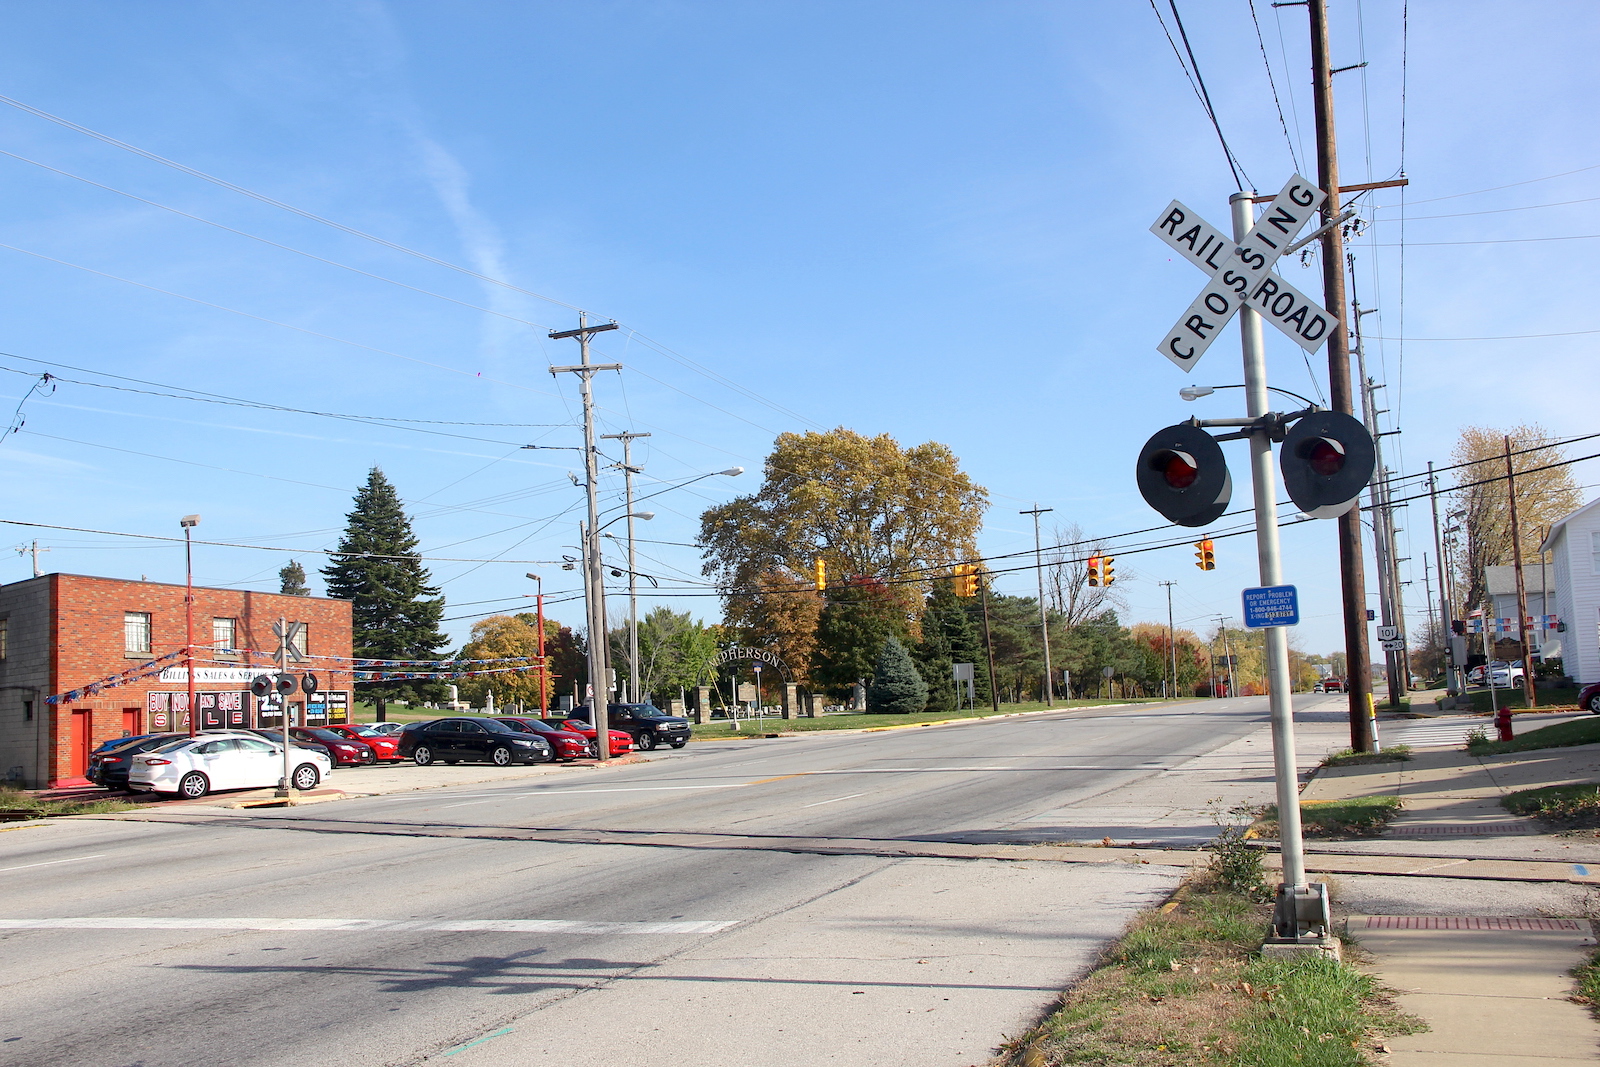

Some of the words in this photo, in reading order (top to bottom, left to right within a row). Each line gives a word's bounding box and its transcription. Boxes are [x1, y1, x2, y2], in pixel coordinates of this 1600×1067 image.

[1159, 207, 1225, 271] RAIL
[1169, 184, 1315, 360] CROSSING
[1252, 277, 1327, 342] ROAD
[1268, 591, 1293, 599] PROBLEM
[1259, 598, 1290, 606] EMERGENCY
[1381, 629, 1394, 637] 101
[1394, 641, 1403, 650] 20
[162, 668, 202, 680] BILLIS
[203, 669, 228, 680] SALES
[230, 672, 236, 680] &
[150, 693, 170, 712] BUY
[201, 694, 215, 708] AND
